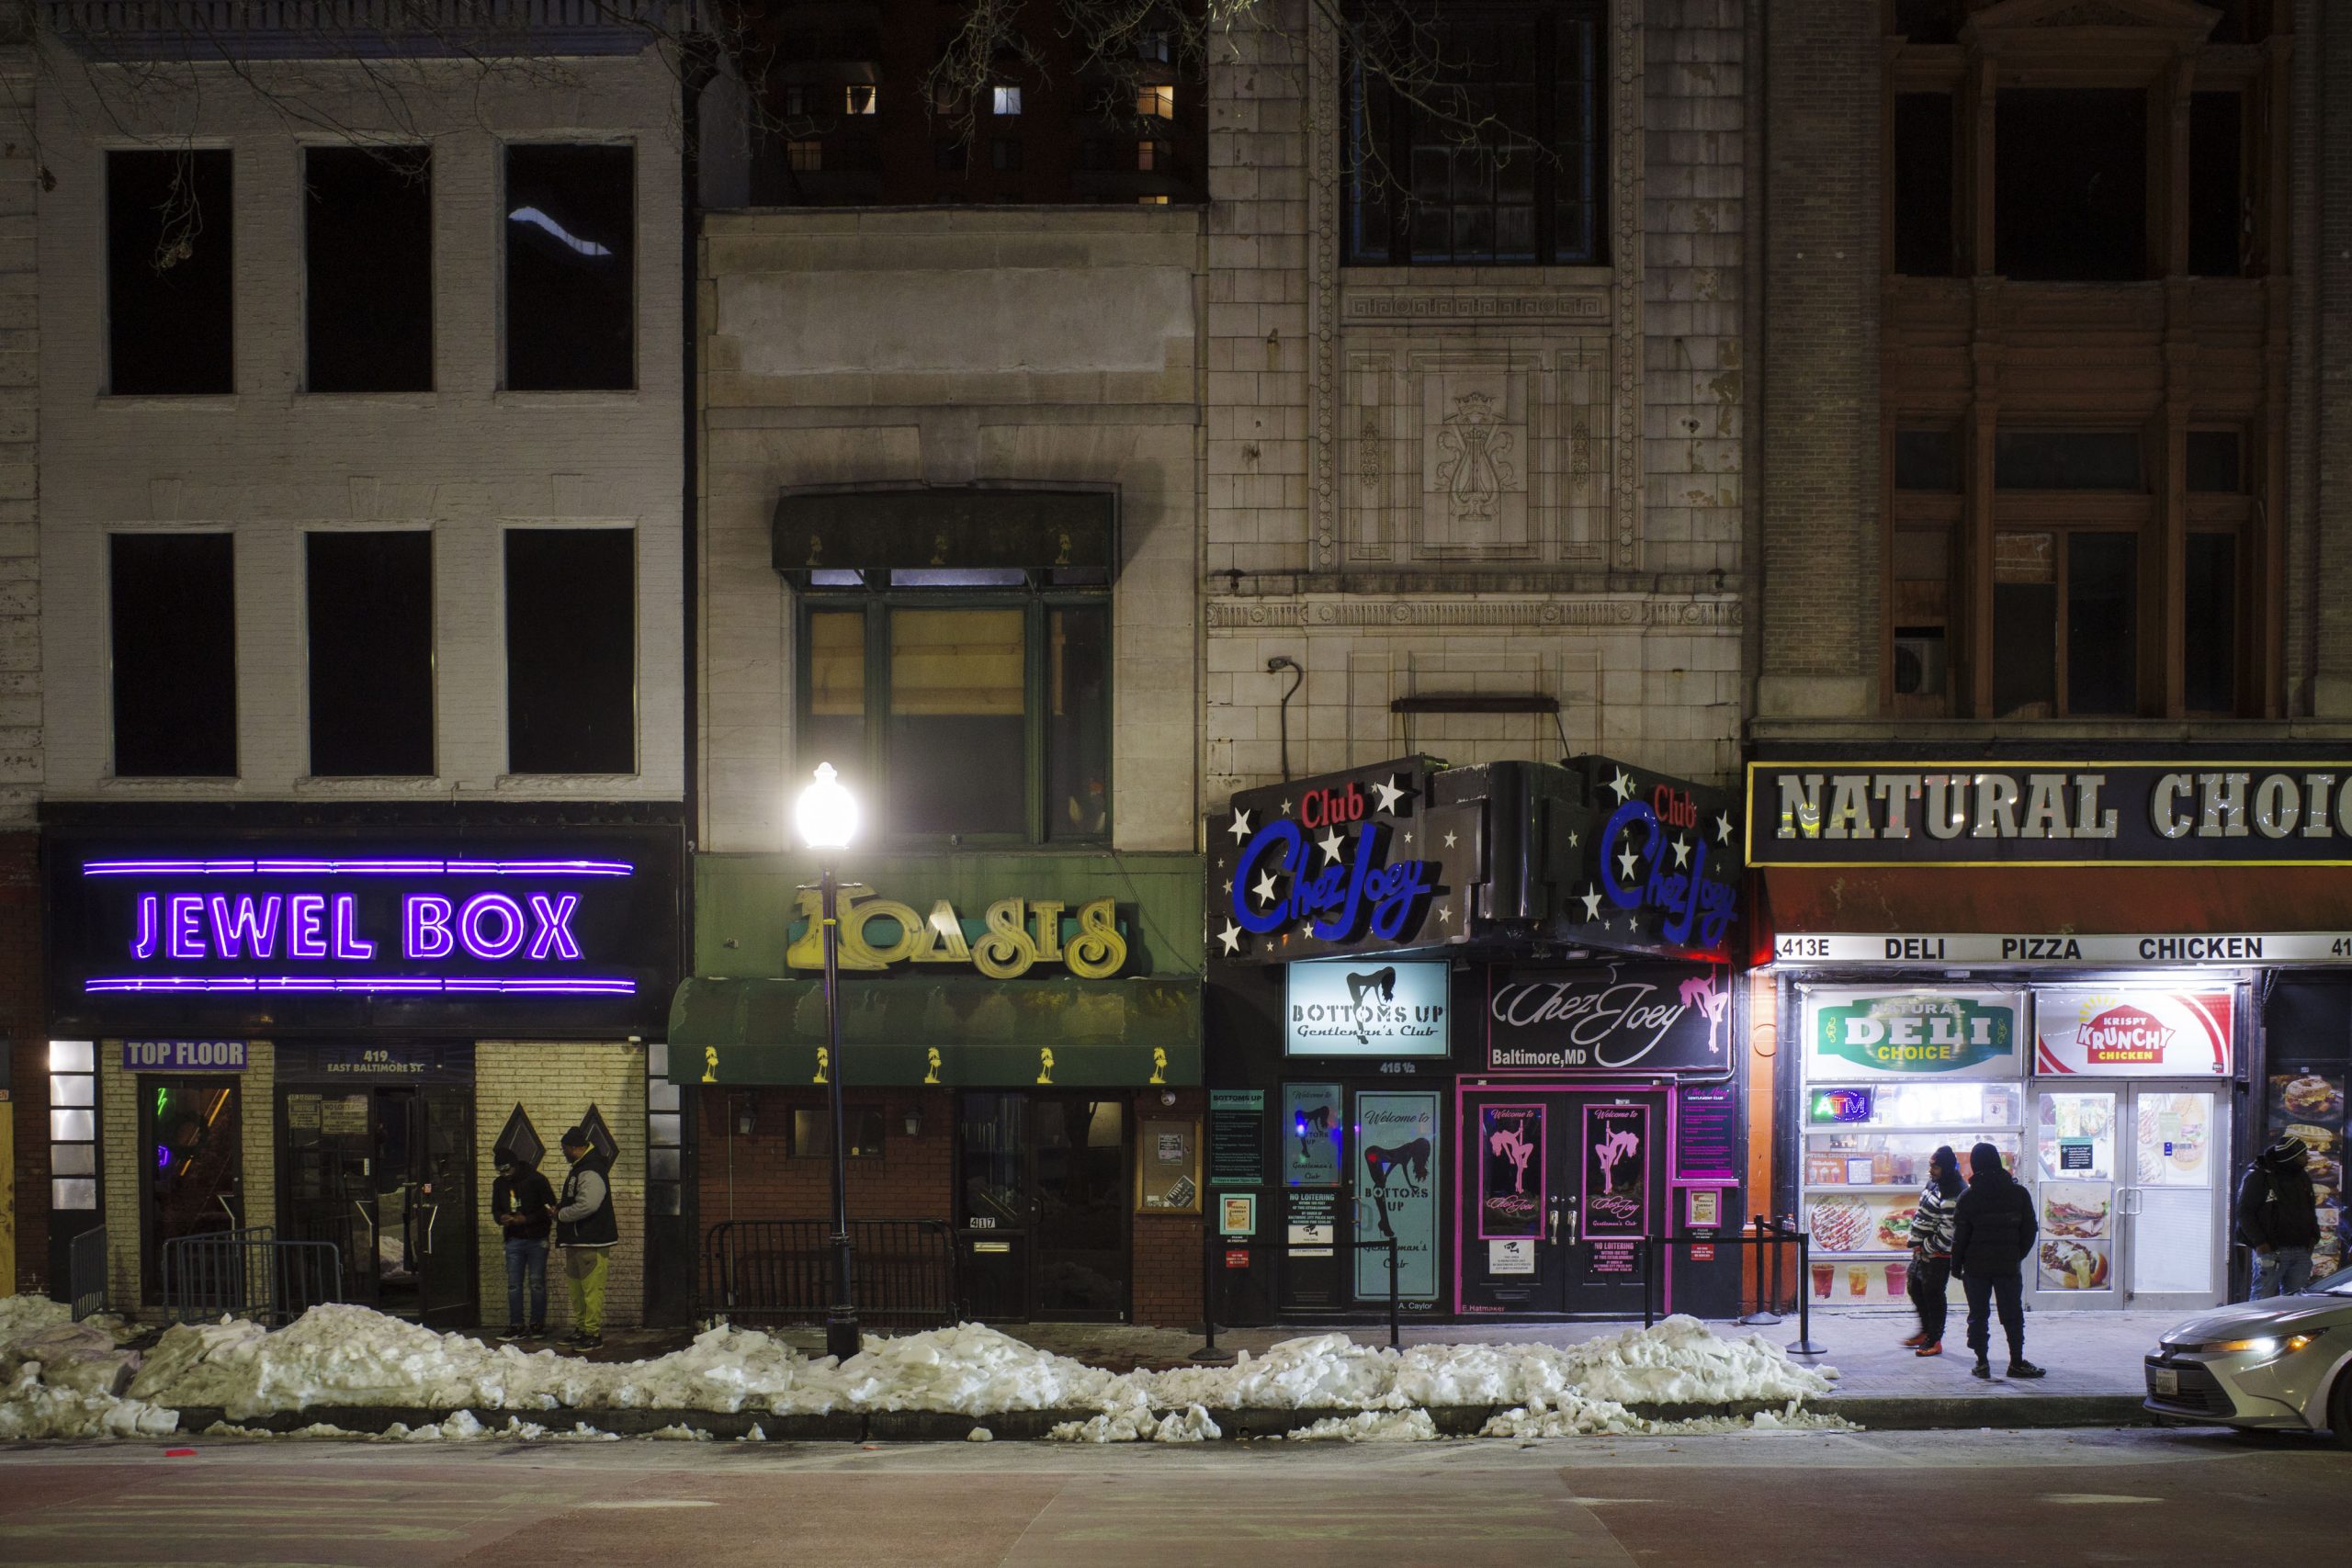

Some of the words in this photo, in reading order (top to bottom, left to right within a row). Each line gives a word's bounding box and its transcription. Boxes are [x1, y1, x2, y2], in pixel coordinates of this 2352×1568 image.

[1302, 782, 1364, 829] Club
[1655, 784, 1697, 829] Club
[1776, 773, 2118, 840] NATURAL
[1232, 819, 1345, 933] Chez
[1313, 821, 1431, 941] Joey
[1600, 799, 1688, 912] Chez
[1663, 838, 1738, 948] Joey
[130, 891, 378, 960] JEWEL
[402, 891, 585, 960] BOX
[843, 897, 1127, 979] OASIS
[1782, 938, 1829, 956] 413E
[1885, 938, 1944, 959] DELI
[2002, 938, 2081, 959] PIZZA
[2139, 937, 2262, 959] CHICKEN
[1293, 1004, 1407, 1022] BOTTOMS
[1415, 1006, 1443, 1022] UP
[1871, 1003, 1965, 1014] NATURAL
[1400, 1025, 1438, 1035] Club
[1492, 982, 1600, 1026] Chez
[1571, 983, 1685, 1066] Joey
[1845, 1017, 1991, 1044] DELI
[2078, 1024, 2175, 1050] KRUNCHY
[128, 1043, 171, 1064] TOP
[176, 1043, 243, 1065] FLOOR
[363, 1050, 389, 1062] 419
[1878, 1045, 1950, 1060] CHOICE
[327, 1064, 351, 1072] EAST
[353, 1064, 408, 1072] BALTIMORE
[1380, 1062, 1401, 1073] 415
[1491, 1109, 1527, 1119] Welcome
[1815, 1097, 1865, 1114] ATM
[1364, 1111, 1417, 1124] Welcome
[1418, 1112, 1430, 1122] to
[1594, 1110, 1629, 1119] Welcome
[1630, 1110, 1637, 1118] to
[1365, 1188, 1428, 1198] BOTTOMS
[1387, 1201, 1404, 1211] UP
[971, 1217, 995, 1228] 417
